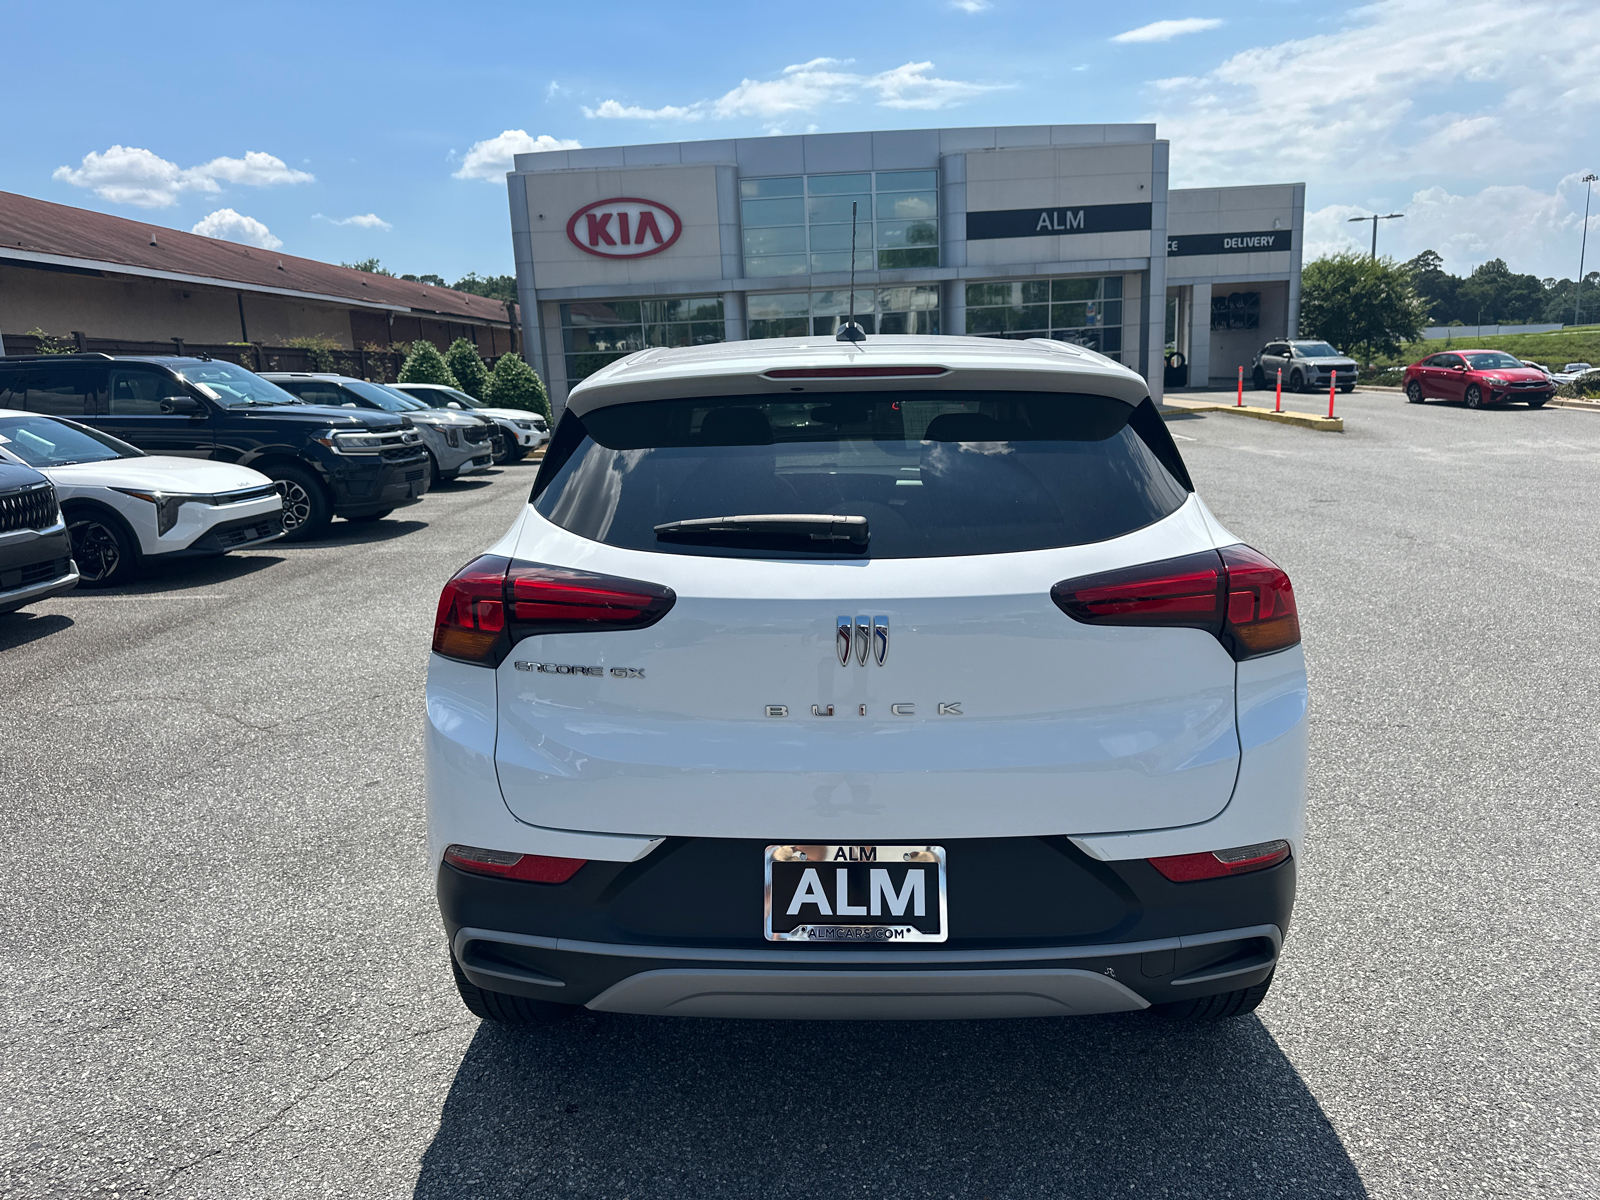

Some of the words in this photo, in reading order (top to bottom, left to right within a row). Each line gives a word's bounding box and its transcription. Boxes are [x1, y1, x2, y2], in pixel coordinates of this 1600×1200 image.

[585, 211, 664, 246] KIA
[1036, 210, 1085, 231] ALM
[1223, 235, 1275, 249] DELIVERY
[513, 660, 604, 678] ENCORE
[609, 666, 646, 680] GX
[764, 702, 964, 718] BUICK
[833, 846, 877, 861] ALM
[785, 867, 926, 917] ALM
[807, 927, 905, 940] ALMCARS.COM
